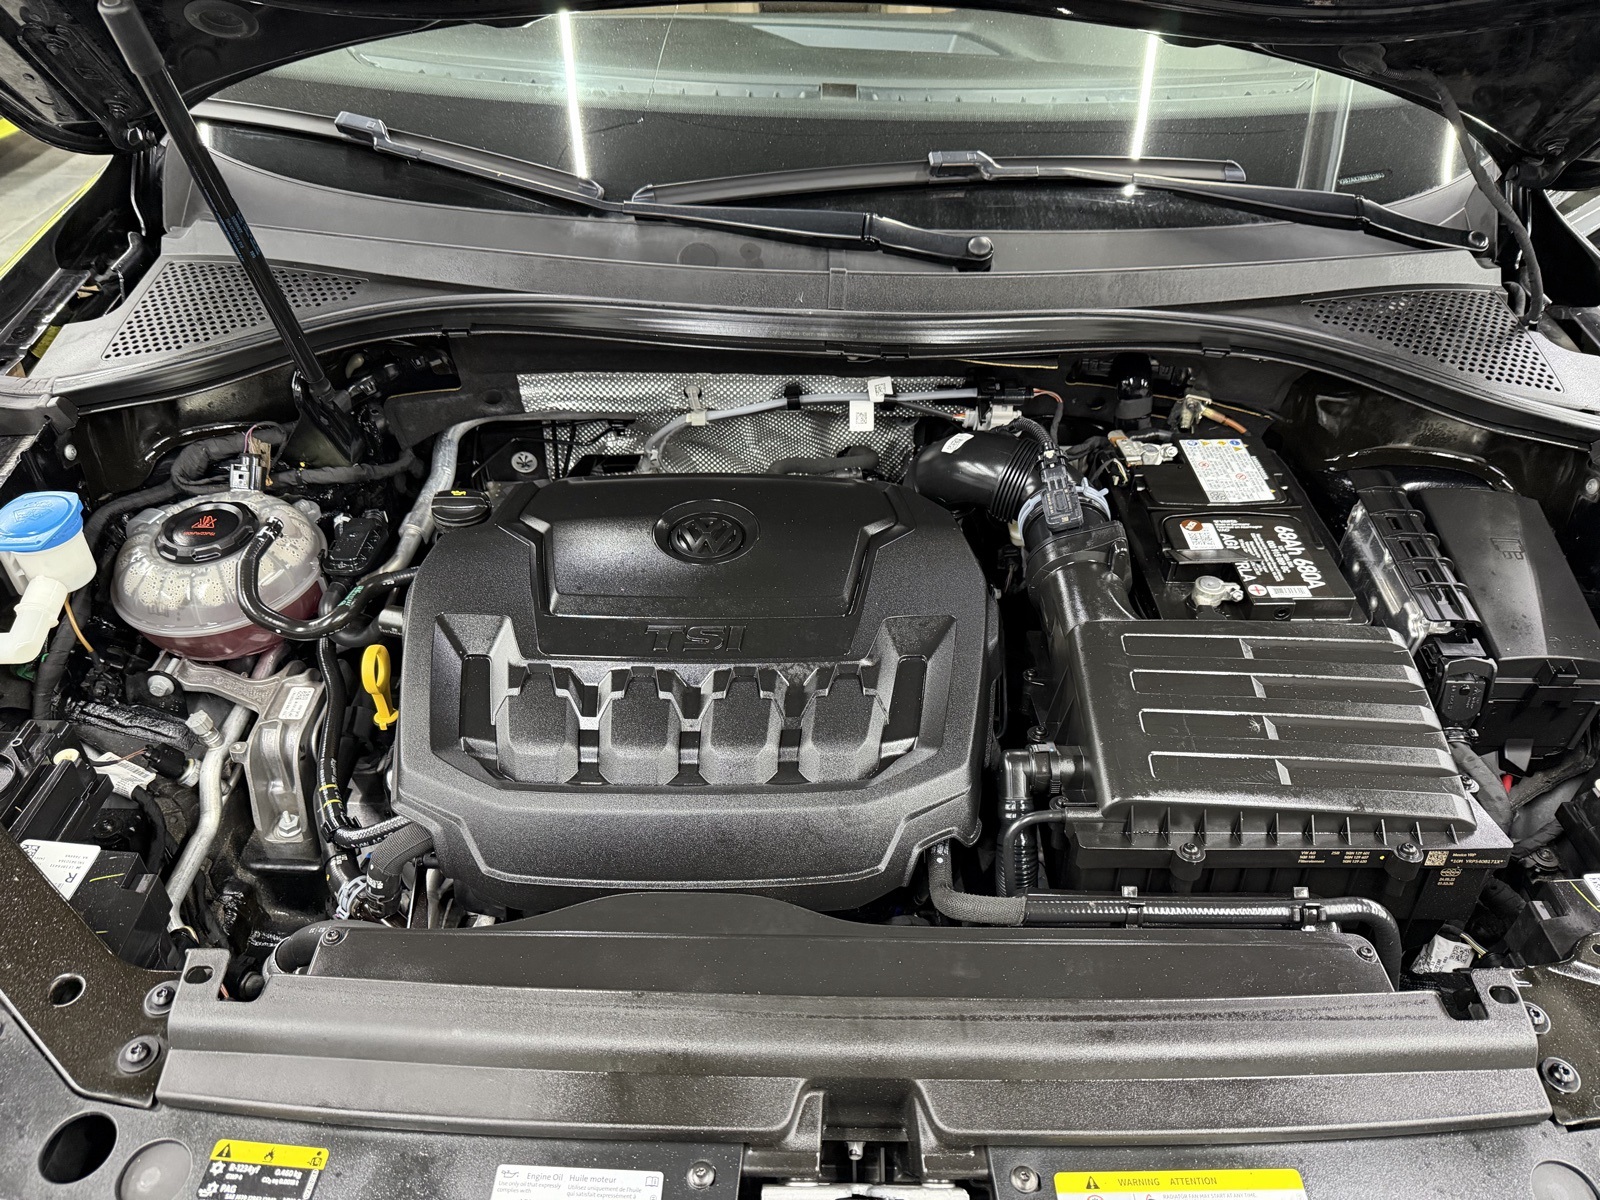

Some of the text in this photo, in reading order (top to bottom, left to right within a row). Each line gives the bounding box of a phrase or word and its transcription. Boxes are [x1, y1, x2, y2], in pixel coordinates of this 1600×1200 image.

[1274, 525, 1326, 589] 68Ah 680A
[1234, 561, 1257, 582] RLA
[645, 624, 747, 652] TSI
[65, 872, 78, 883] R
[527, 1173, 563, 1182] Engine Oil
[569, 1174, 588, 1182] Huile
[1118, 1177, 1217, 1186] WARNING ATTENTION
